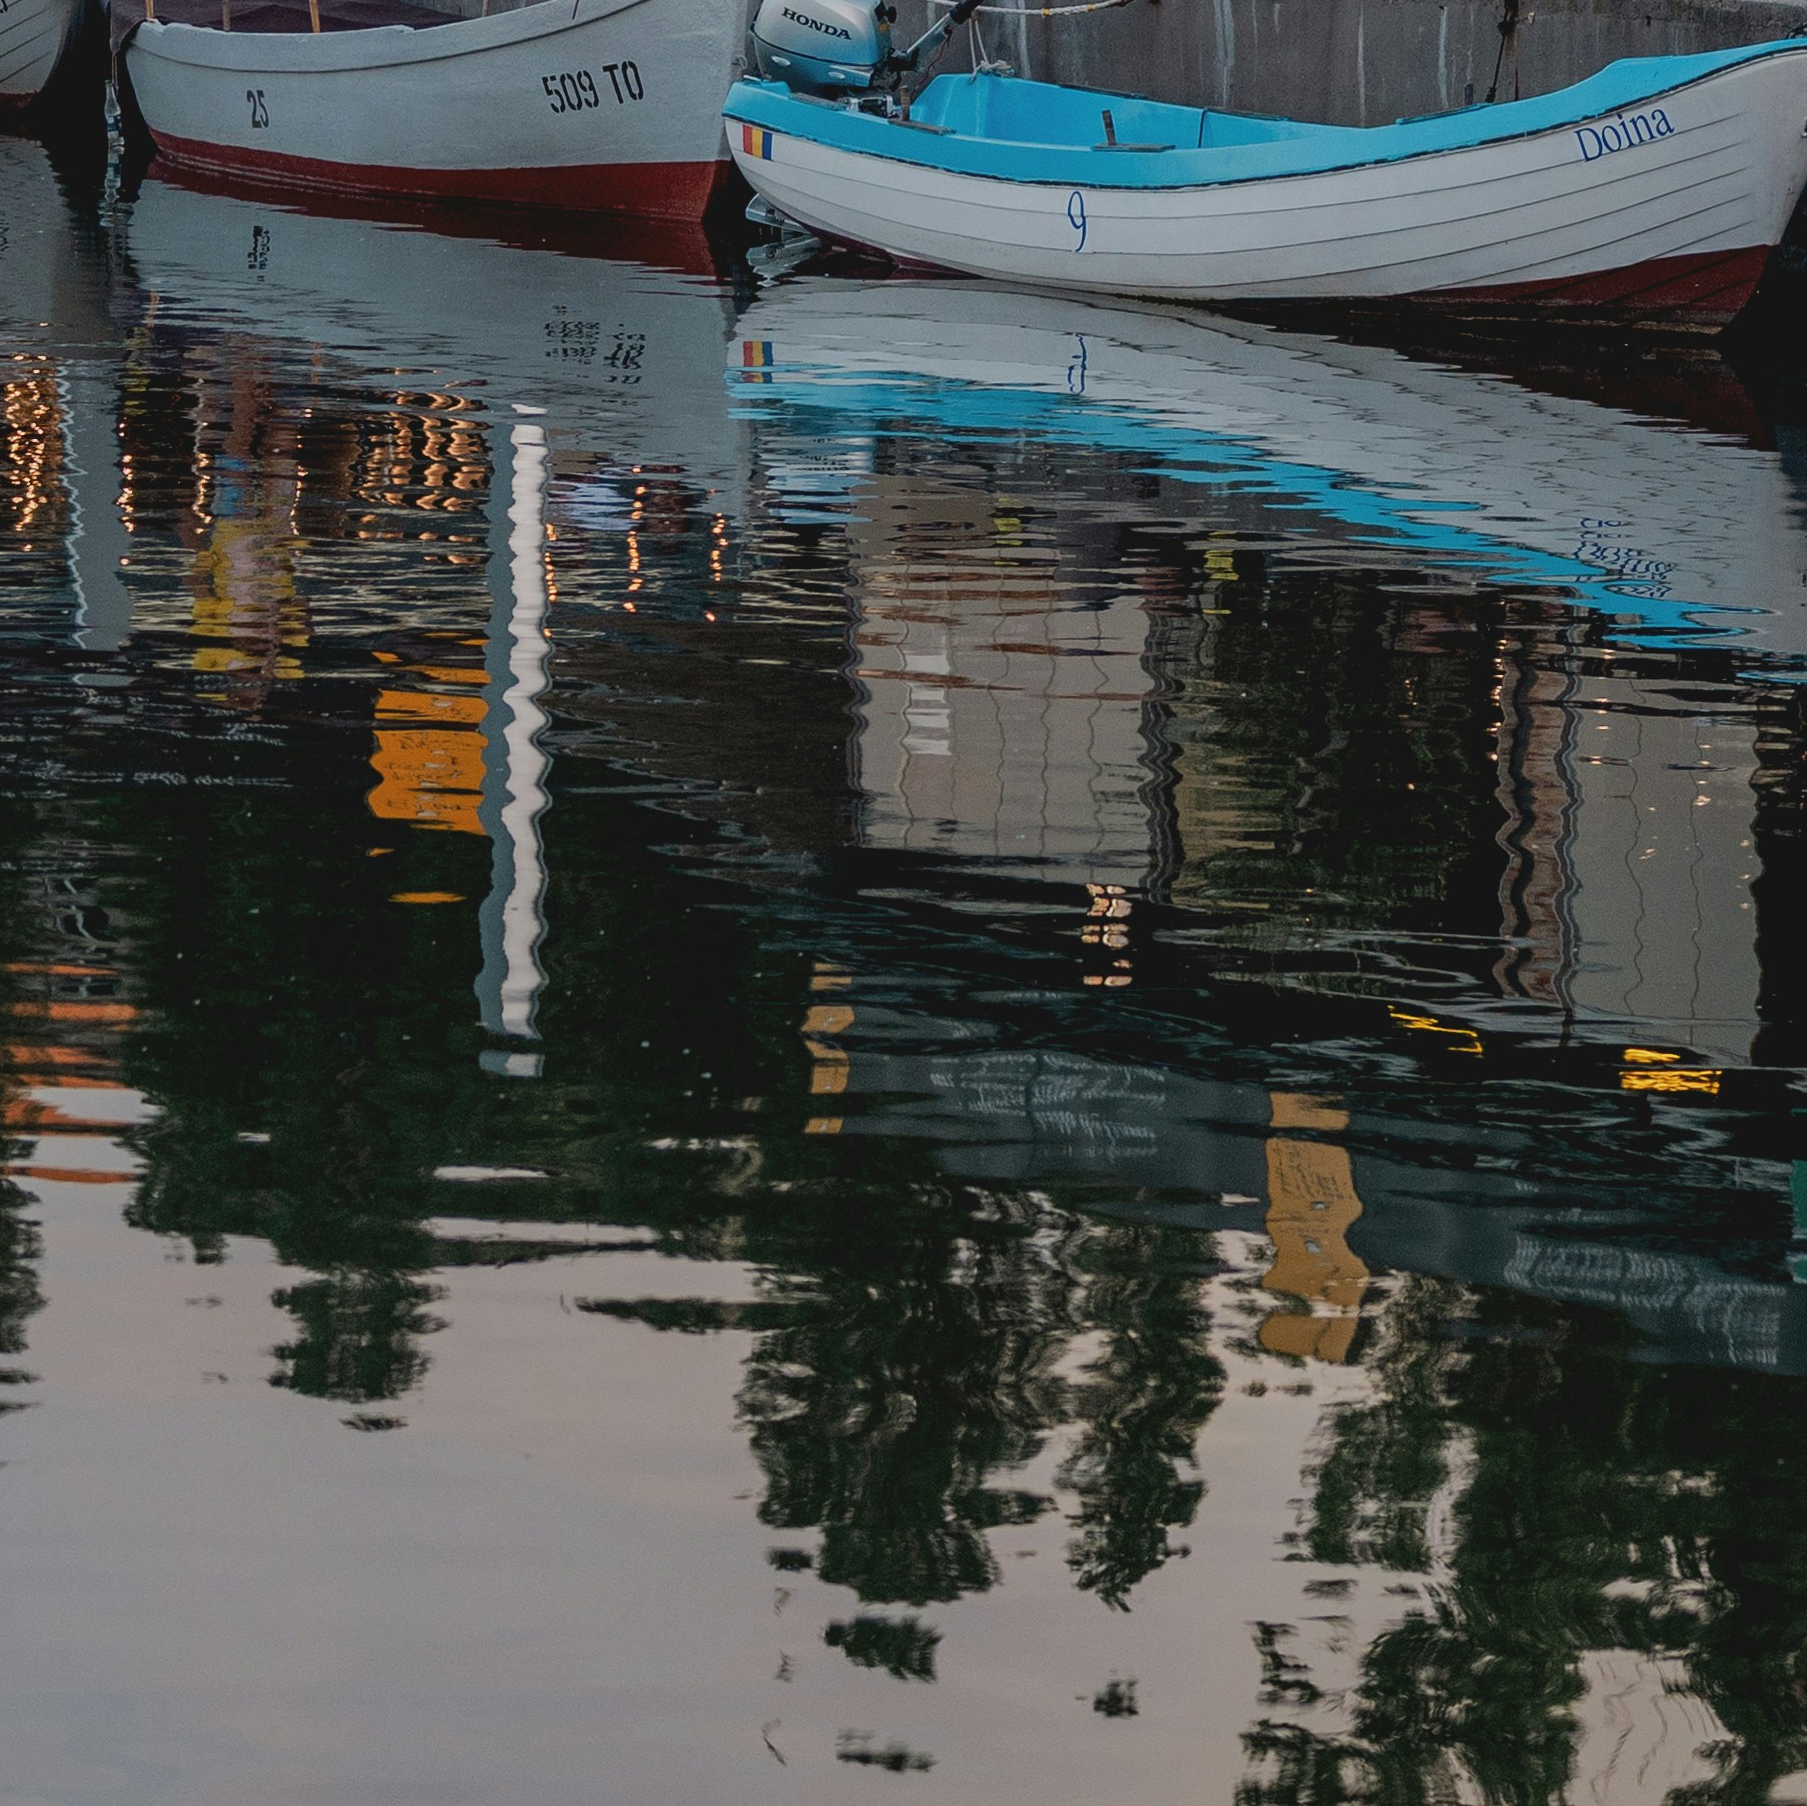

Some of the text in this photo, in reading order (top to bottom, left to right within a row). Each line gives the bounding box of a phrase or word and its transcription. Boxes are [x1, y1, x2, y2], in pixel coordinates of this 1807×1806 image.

[782, 7, 852, 40] HONDA
[246, 89, 269, 129] 25
[541, 61, 644, 113] 509 TO
[1574, 109, 1674, 162] Doina
[1068, 191, 1086, 252] 9
